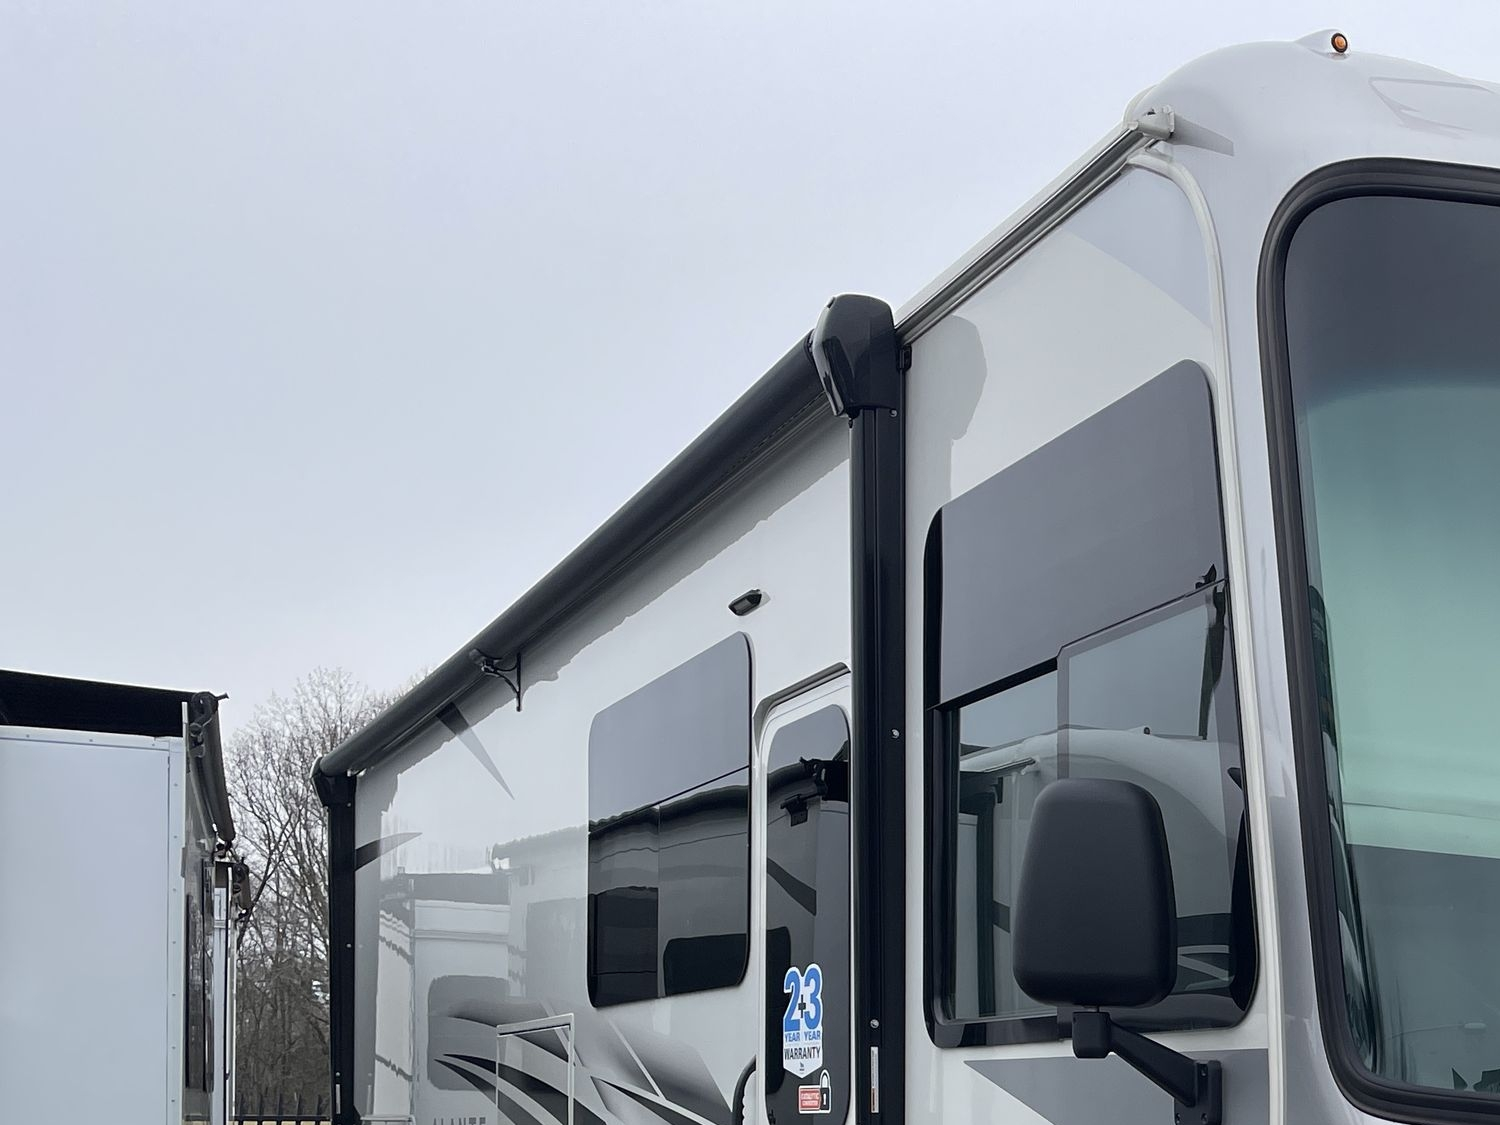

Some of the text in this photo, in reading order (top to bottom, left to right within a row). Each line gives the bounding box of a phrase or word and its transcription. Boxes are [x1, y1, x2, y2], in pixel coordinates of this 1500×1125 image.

[785, 1030, 821, 1042] YEAR YEAR
[784, 1046, 820, 1060] WARRANTY
